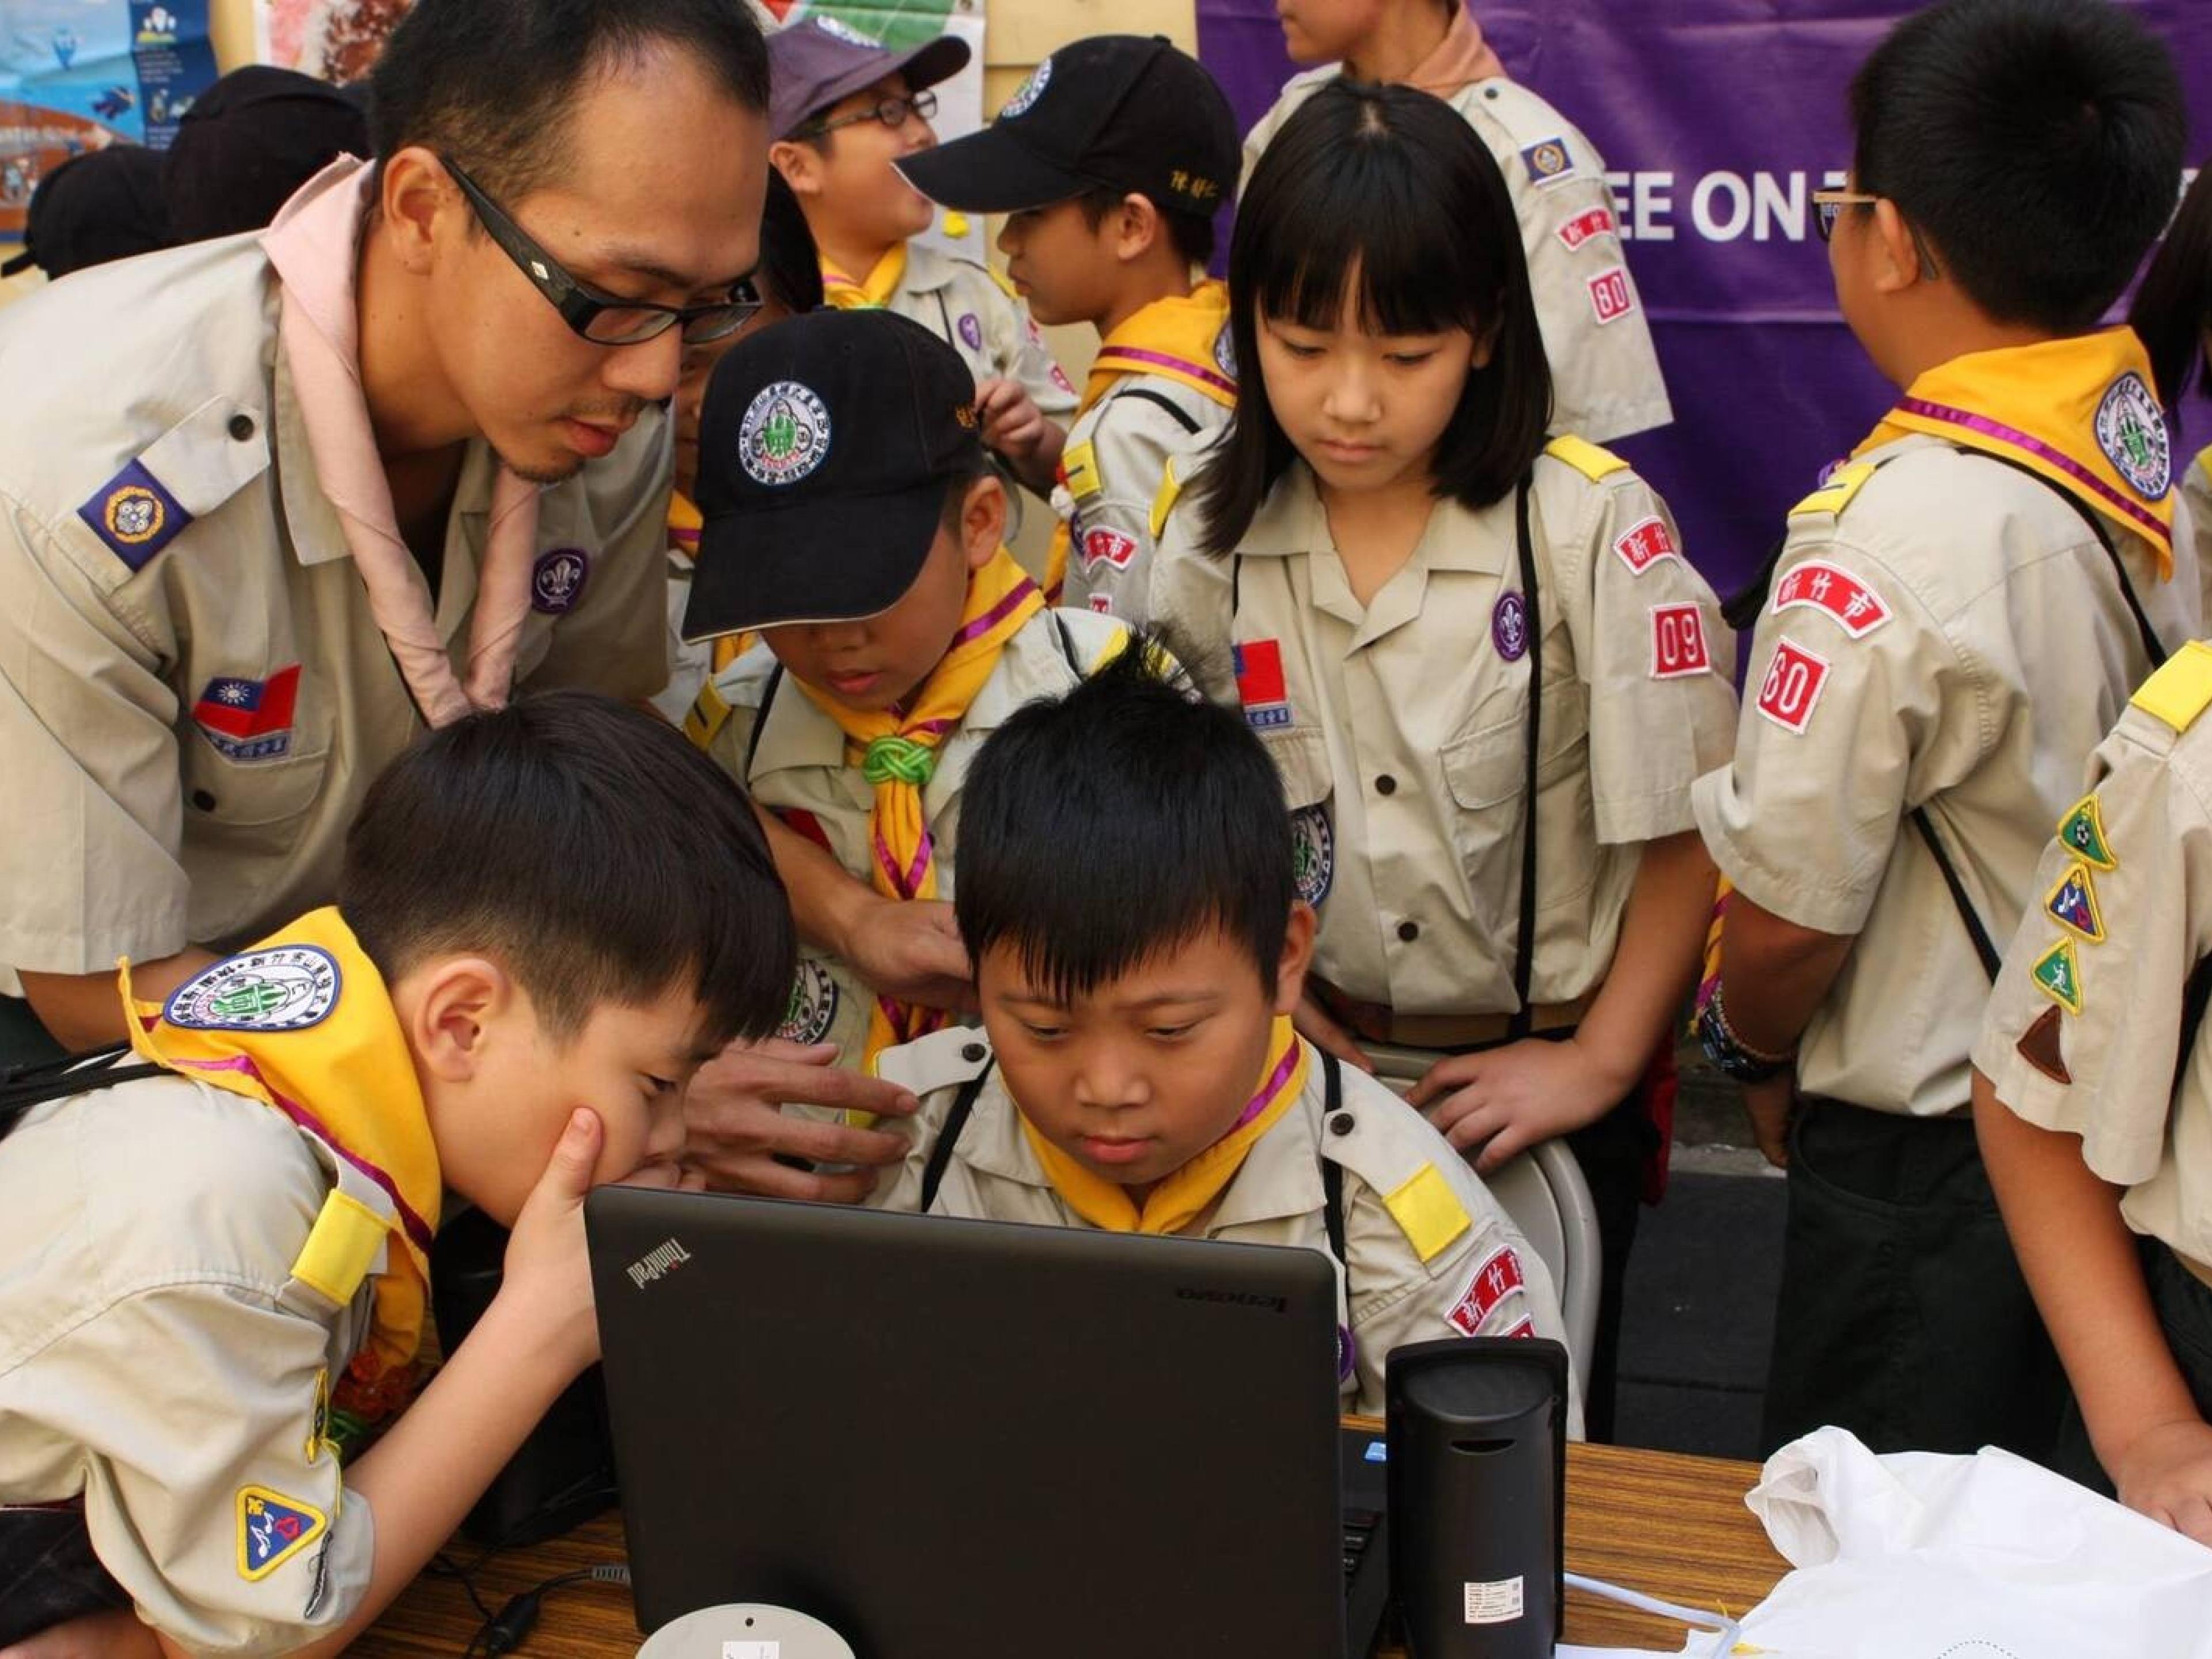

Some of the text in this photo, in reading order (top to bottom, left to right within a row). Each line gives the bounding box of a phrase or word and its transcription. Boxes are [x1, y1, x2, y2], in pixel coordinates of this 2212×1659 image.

[1692, 171, 1806, 242] ON
[1662, 613, 1699, 665] 09
[626, 1238, 691, 1289] ThinkPad
